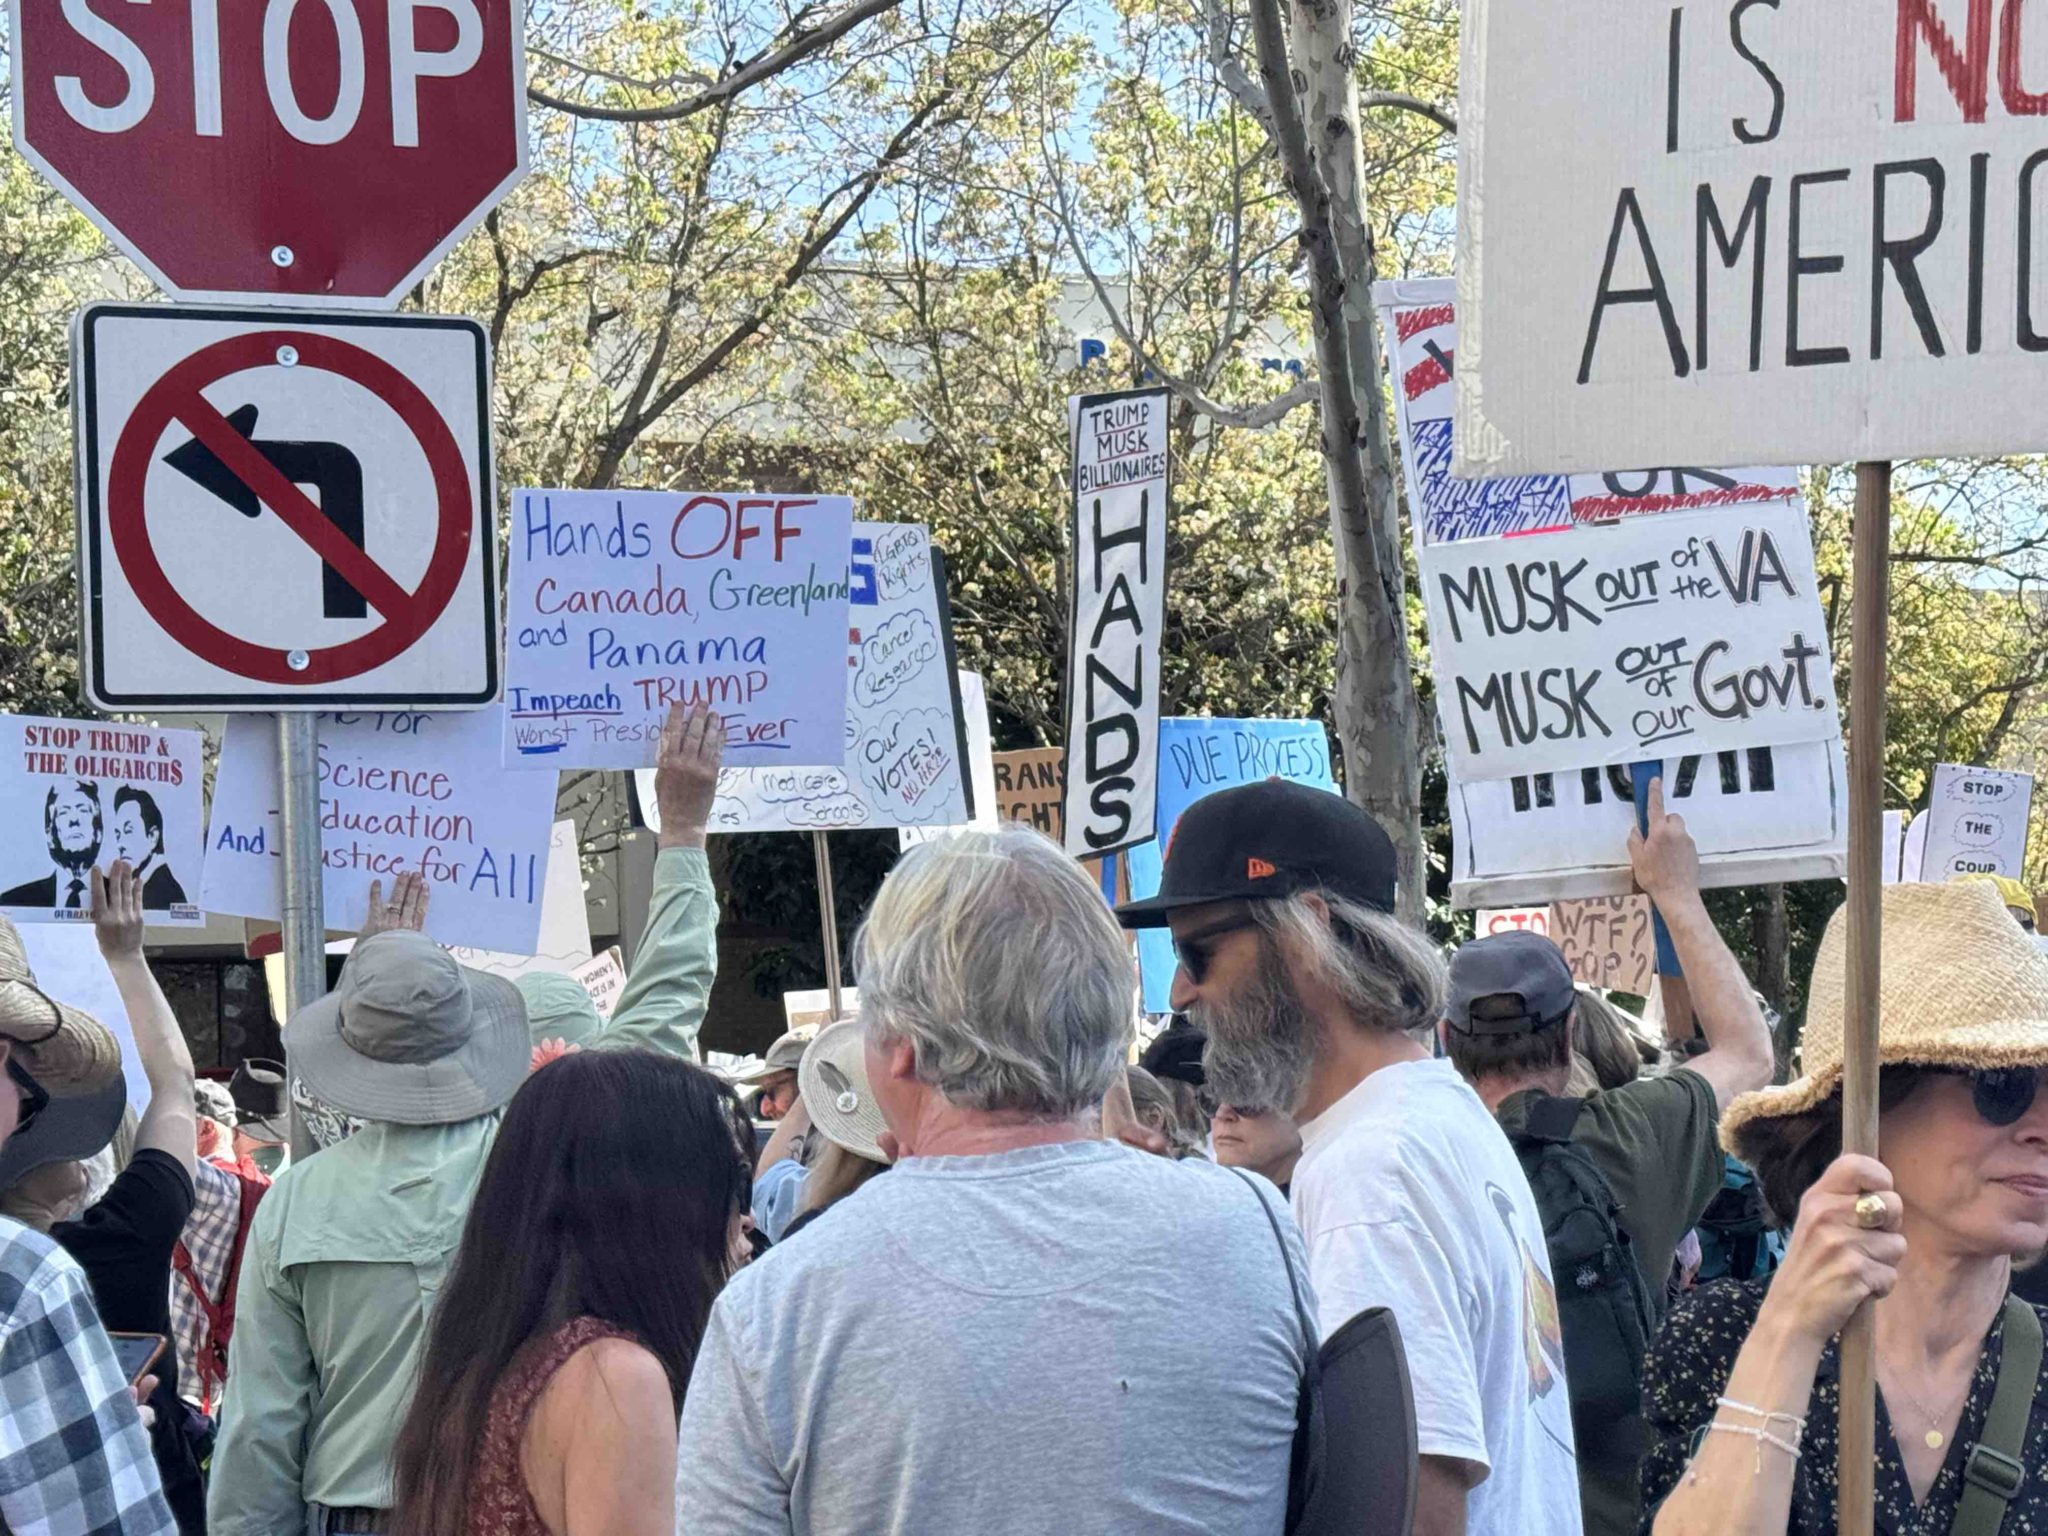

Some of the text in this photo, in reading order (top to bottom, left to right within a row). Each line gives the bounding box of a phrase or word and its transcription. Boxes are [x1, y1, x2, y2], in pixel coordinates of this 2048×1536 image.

[54, 0, 484, 148] STOP
[1667, 0, 1785, 154] IS
[1090, 403, 1149, 434] TRUMP
[1097, 430, 1149, 460] MUSK
[1080, 452, 1165, 492] BILLIONAIRES
[525, 496, 818, 562] Hands OFF
[879, 531, 919, 565] LGBTQ
[881, 552, 927, 590] Rights
[1671, 537, 1699, 567] of
[1705, 529, 1797, 604] VA
[535, 564, 700, 624] Canada,
[709, 563, 849, 616] Greenland
[1439, 558, 1602, 642] MUSK
[1670, 576, 1720, 599] the
[519, 620, 766, 669] and Panama
[871, 619, 917, 664] Cancer
[865, 642, 931, 693] Research
[1084, 488, 1149, 849] HANDS
[508, 672, 767, 720] Impeach TRUMP
[1456, 667, 1611, 753] MUSK
[1645, 669, 1677, 697] of
[25, 725, 170, 757] STOP TRUMP &
[515, 720, 577, 745] Worst
[720, 713, 798, 742] Ever
[866, 722, 900, 763] Our
[25, 752, 67, 775] THE
[872, 728, 936, 796] VOTES!
[1170, 731, 1325, 789] DUE PROCESS
[901, 779, 919, 805] NO
[1963, 781, 2003, 797] STOP
[320, 798, 473, 844] ducation
[803, 801, 865, 821] Schools
[1965, 820, 1992, 835] THE
[217, 824, 265, 854] And
[415, 845, 465, 884] for
[470, 847, 536, 903] All
[1955, 860, 1996, 874] COUP
